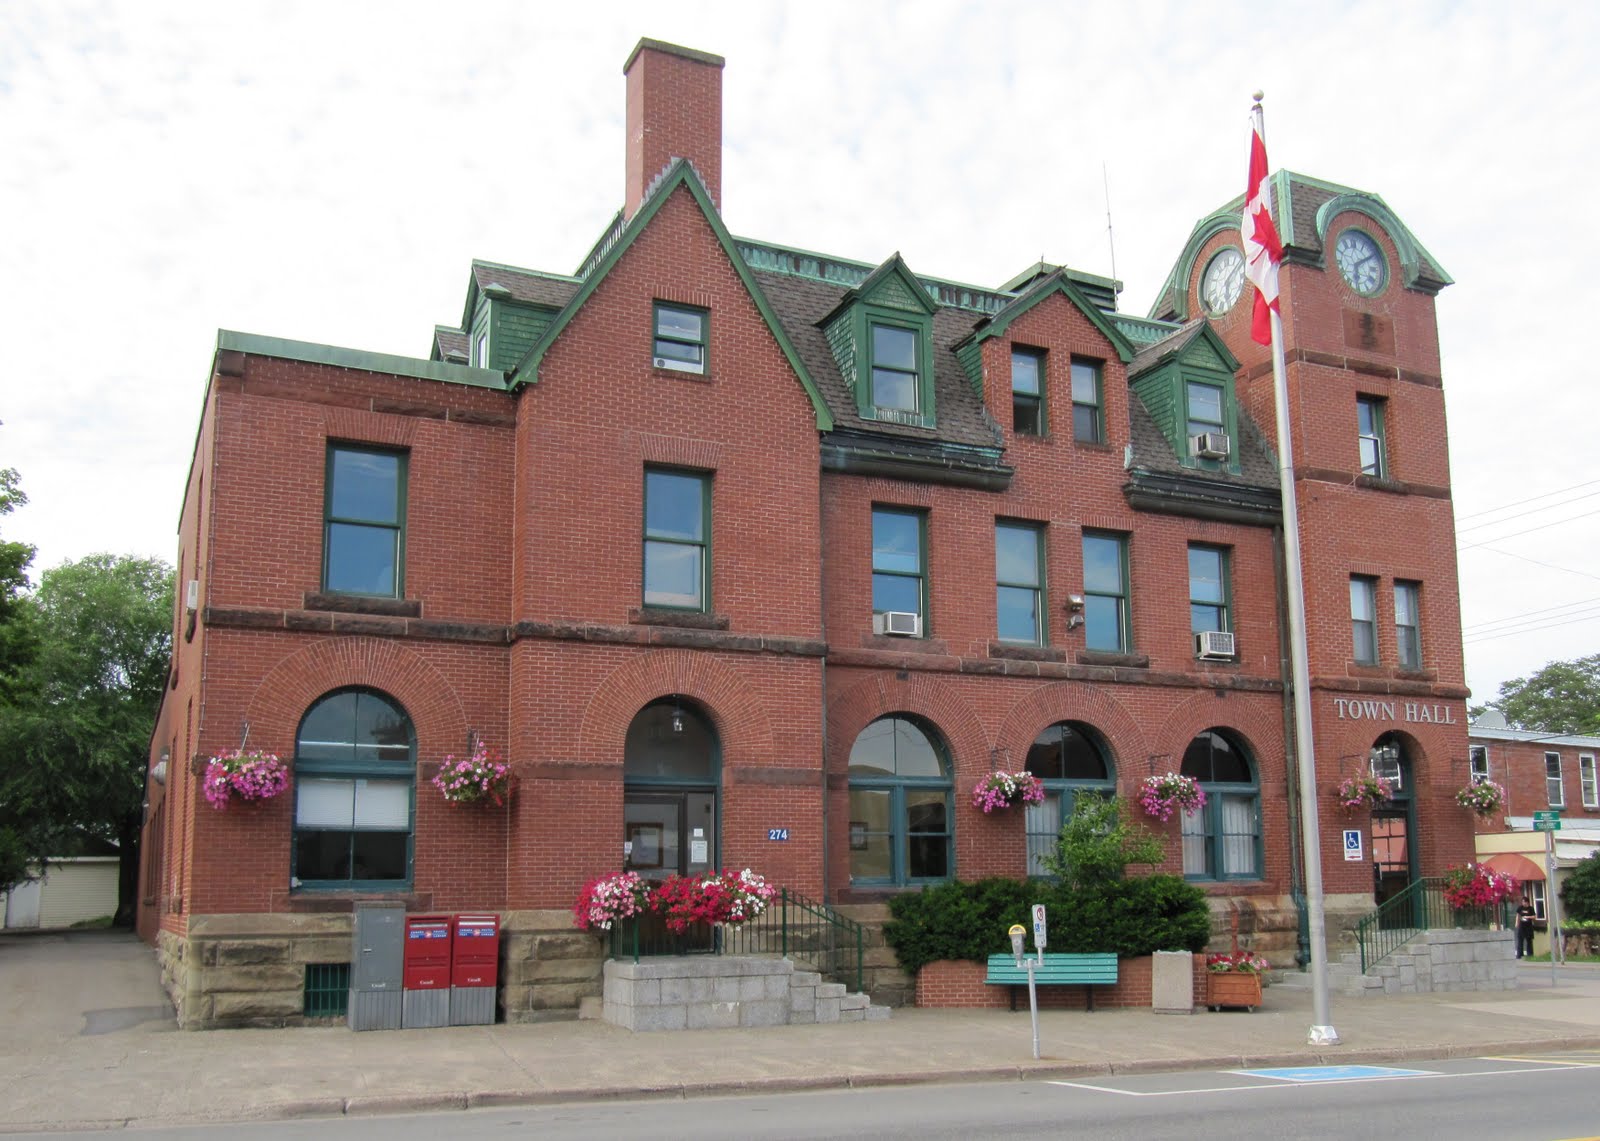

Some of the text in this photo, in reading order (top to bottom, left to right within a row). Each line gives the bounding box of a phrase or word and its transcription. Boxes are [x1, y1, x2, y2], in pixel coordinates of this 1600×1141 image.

[1334, 698, 1457, 724] TOWN HALL
[769, 829, 788, 840] 274
